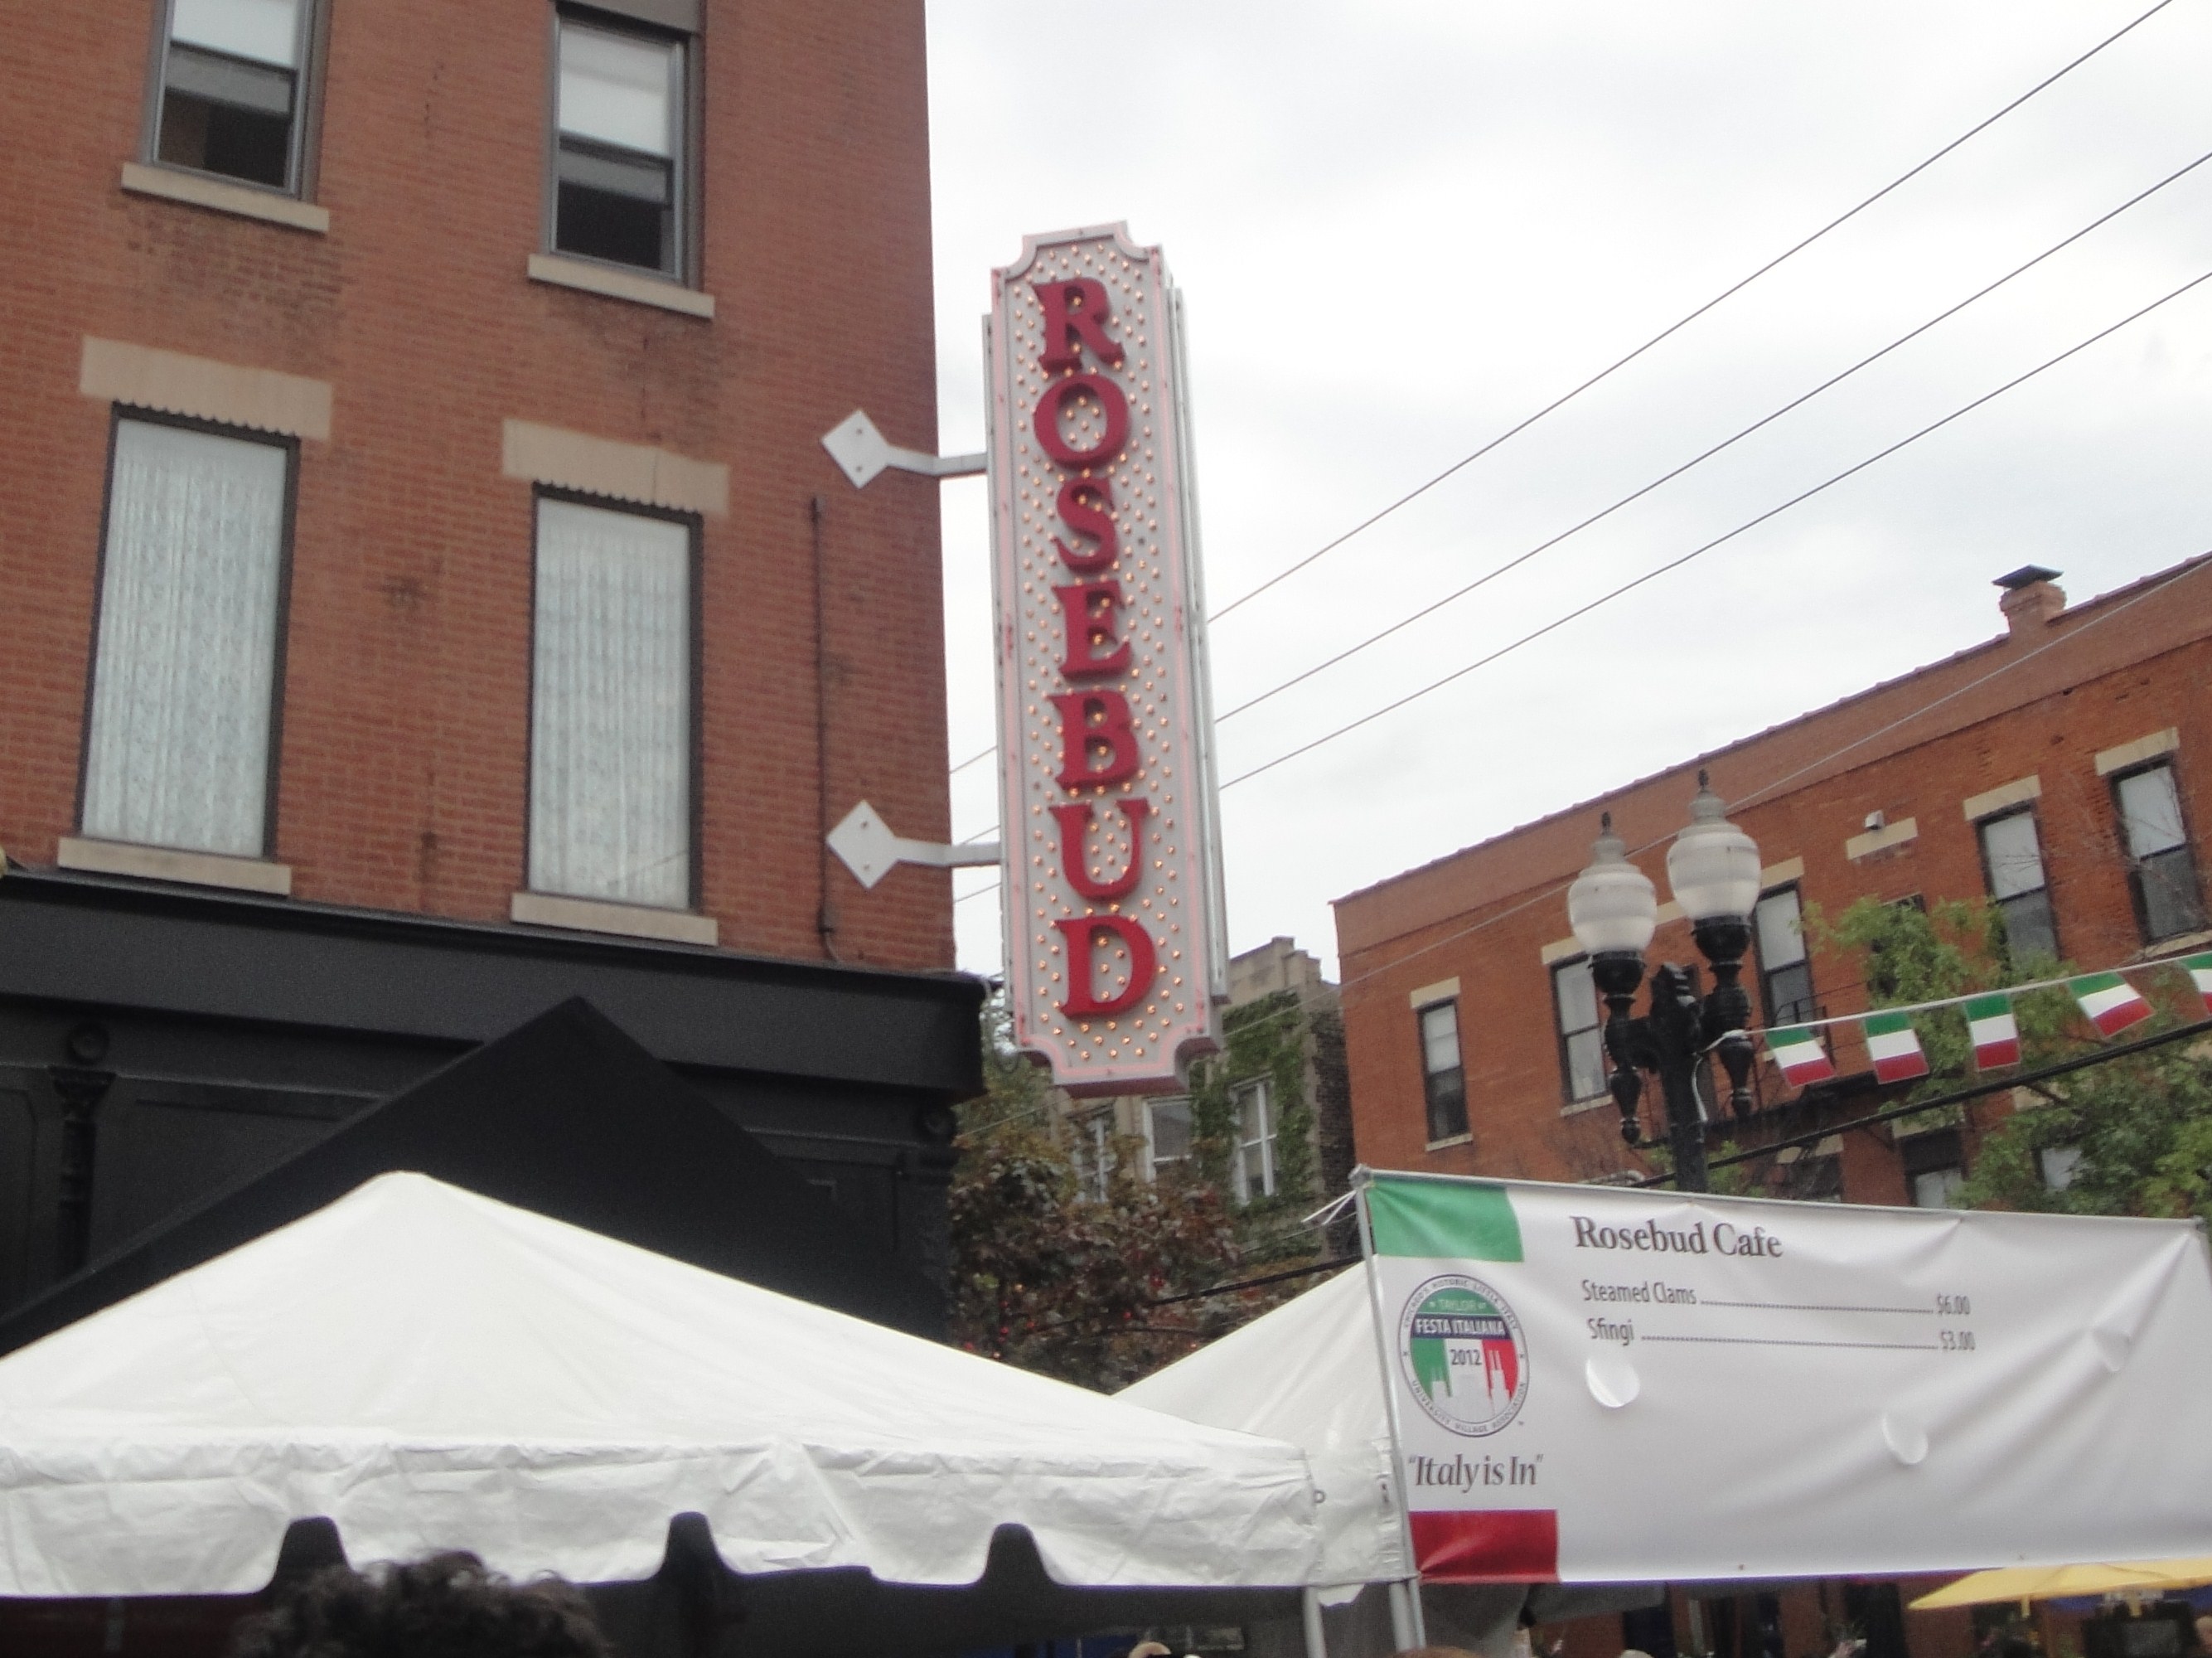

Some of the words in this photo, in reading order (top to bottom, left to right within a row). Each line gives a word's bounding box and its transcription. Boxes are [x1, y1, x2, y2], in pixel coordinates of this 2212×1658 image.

[1031, 276, 1156, 1020] ROSEBUD
[1570, 1215, 1708, 1254] Rosebud
[1713, 1223, 1784, 1256] Cafe
[1582, 1279, 1650, 1302] Steamed
[1653, 1282, 1697, 1304] Clams
[1938, 1293, 1970, 1316] $6.00
[1416, 1318, 1452, 1334] FESTA
[1452, 1319, 1506, 1336] ITALIANA
[1587, 1318, 1634, 1345] Sfingi
[1941, 1331, 1975, 1351] $3.00
[1450, 1348, 1483, 1365] 2012
[1484, 1455, 1504, 1485] is
